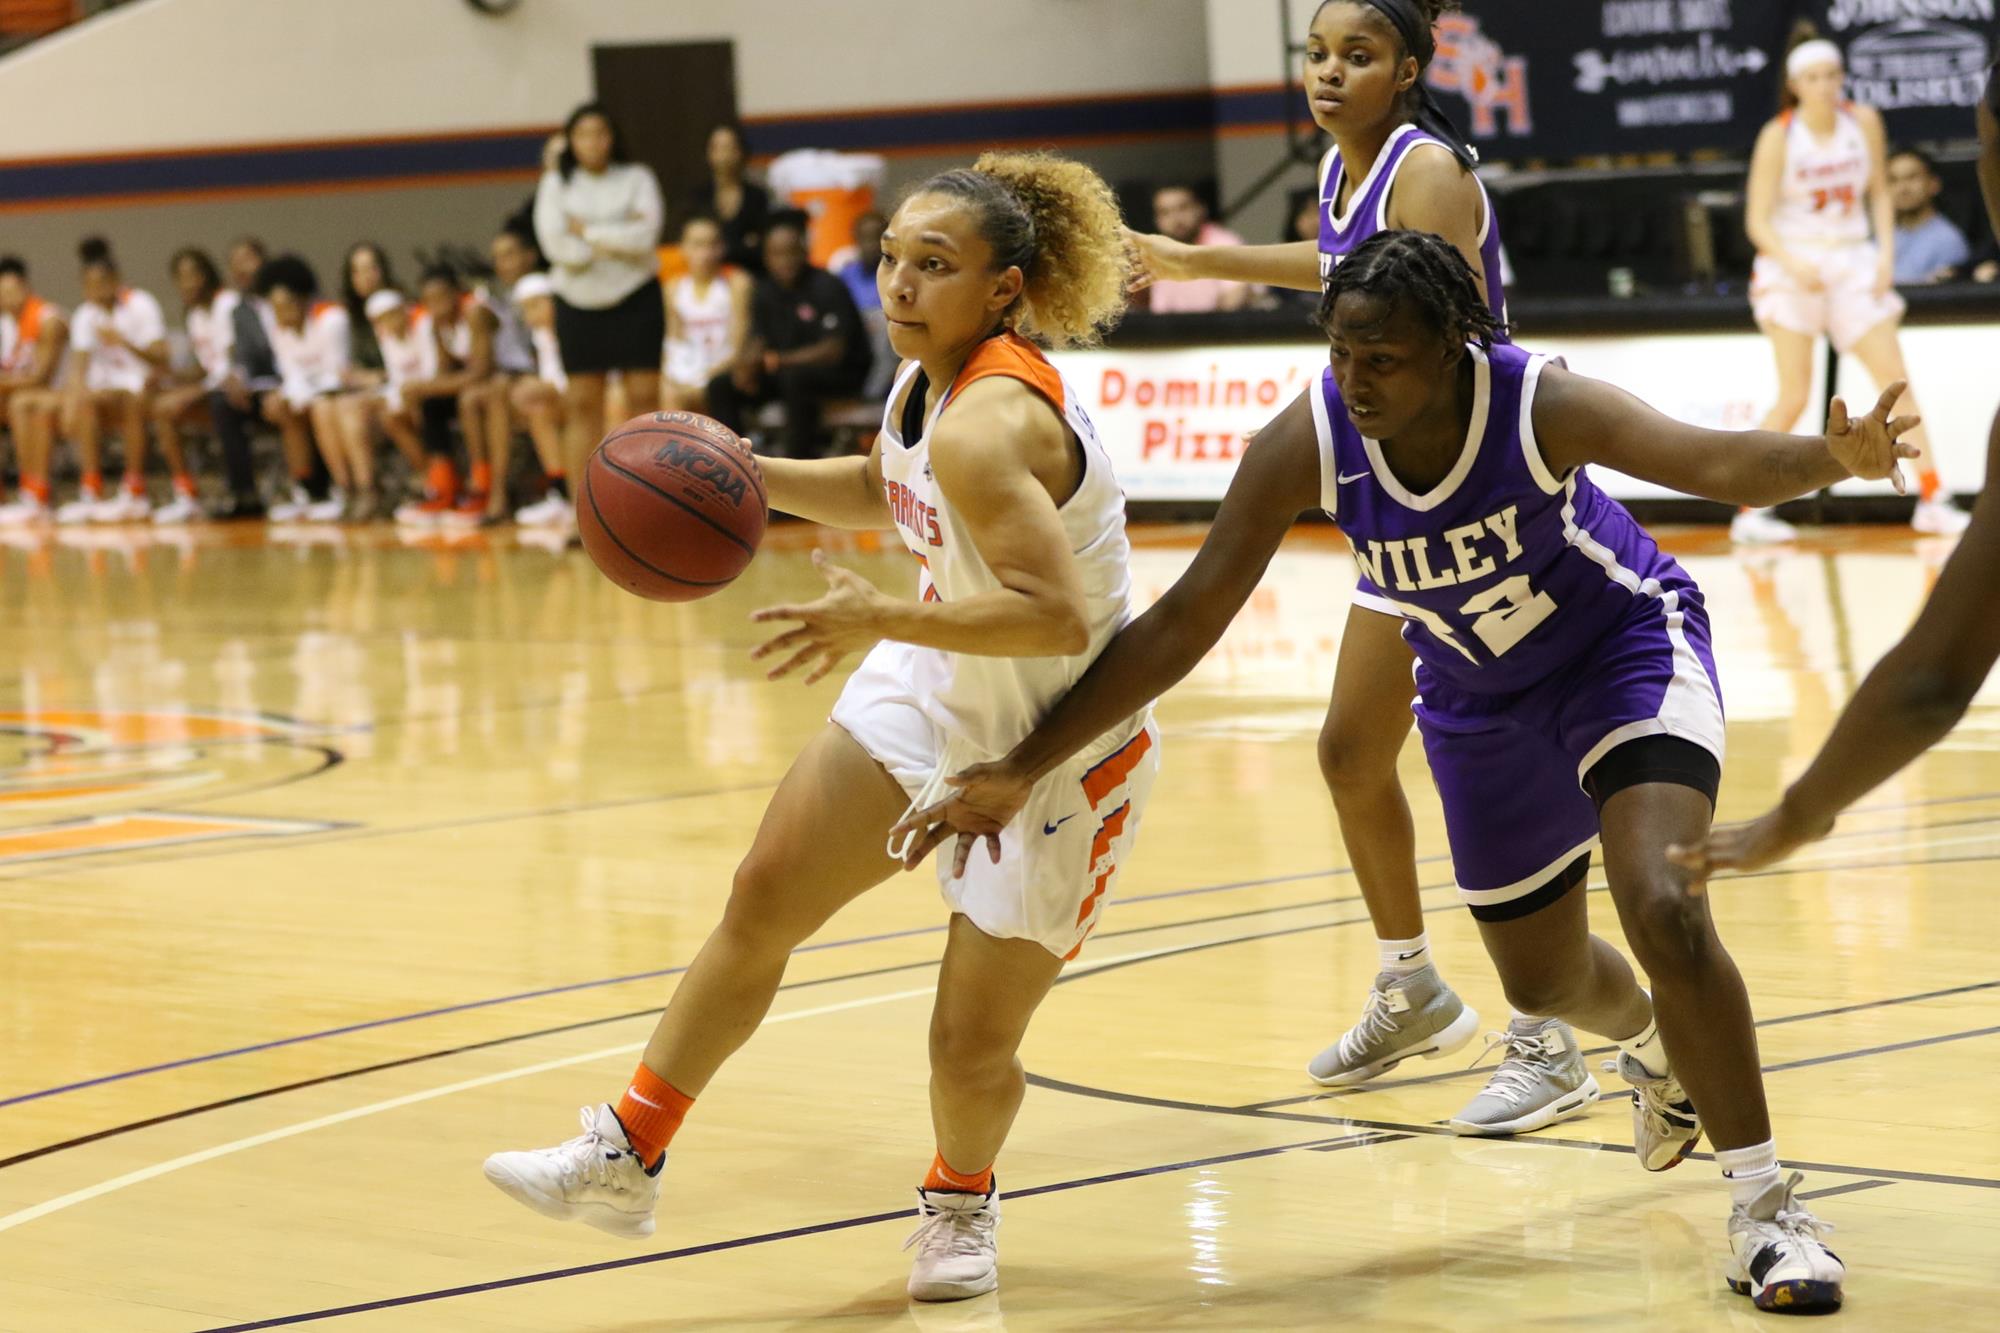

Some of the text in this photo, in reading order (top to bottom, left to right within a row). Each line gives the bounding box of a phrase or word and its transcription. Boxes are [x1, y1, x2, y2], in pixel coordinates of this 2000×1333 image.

[1098, 364, 1312, 408] Domino'
[1141, 417, 1250, 461] Pizz
[655, 439, 747, 508] NCAA
[1346, 504, 1524, 591] WILEY
